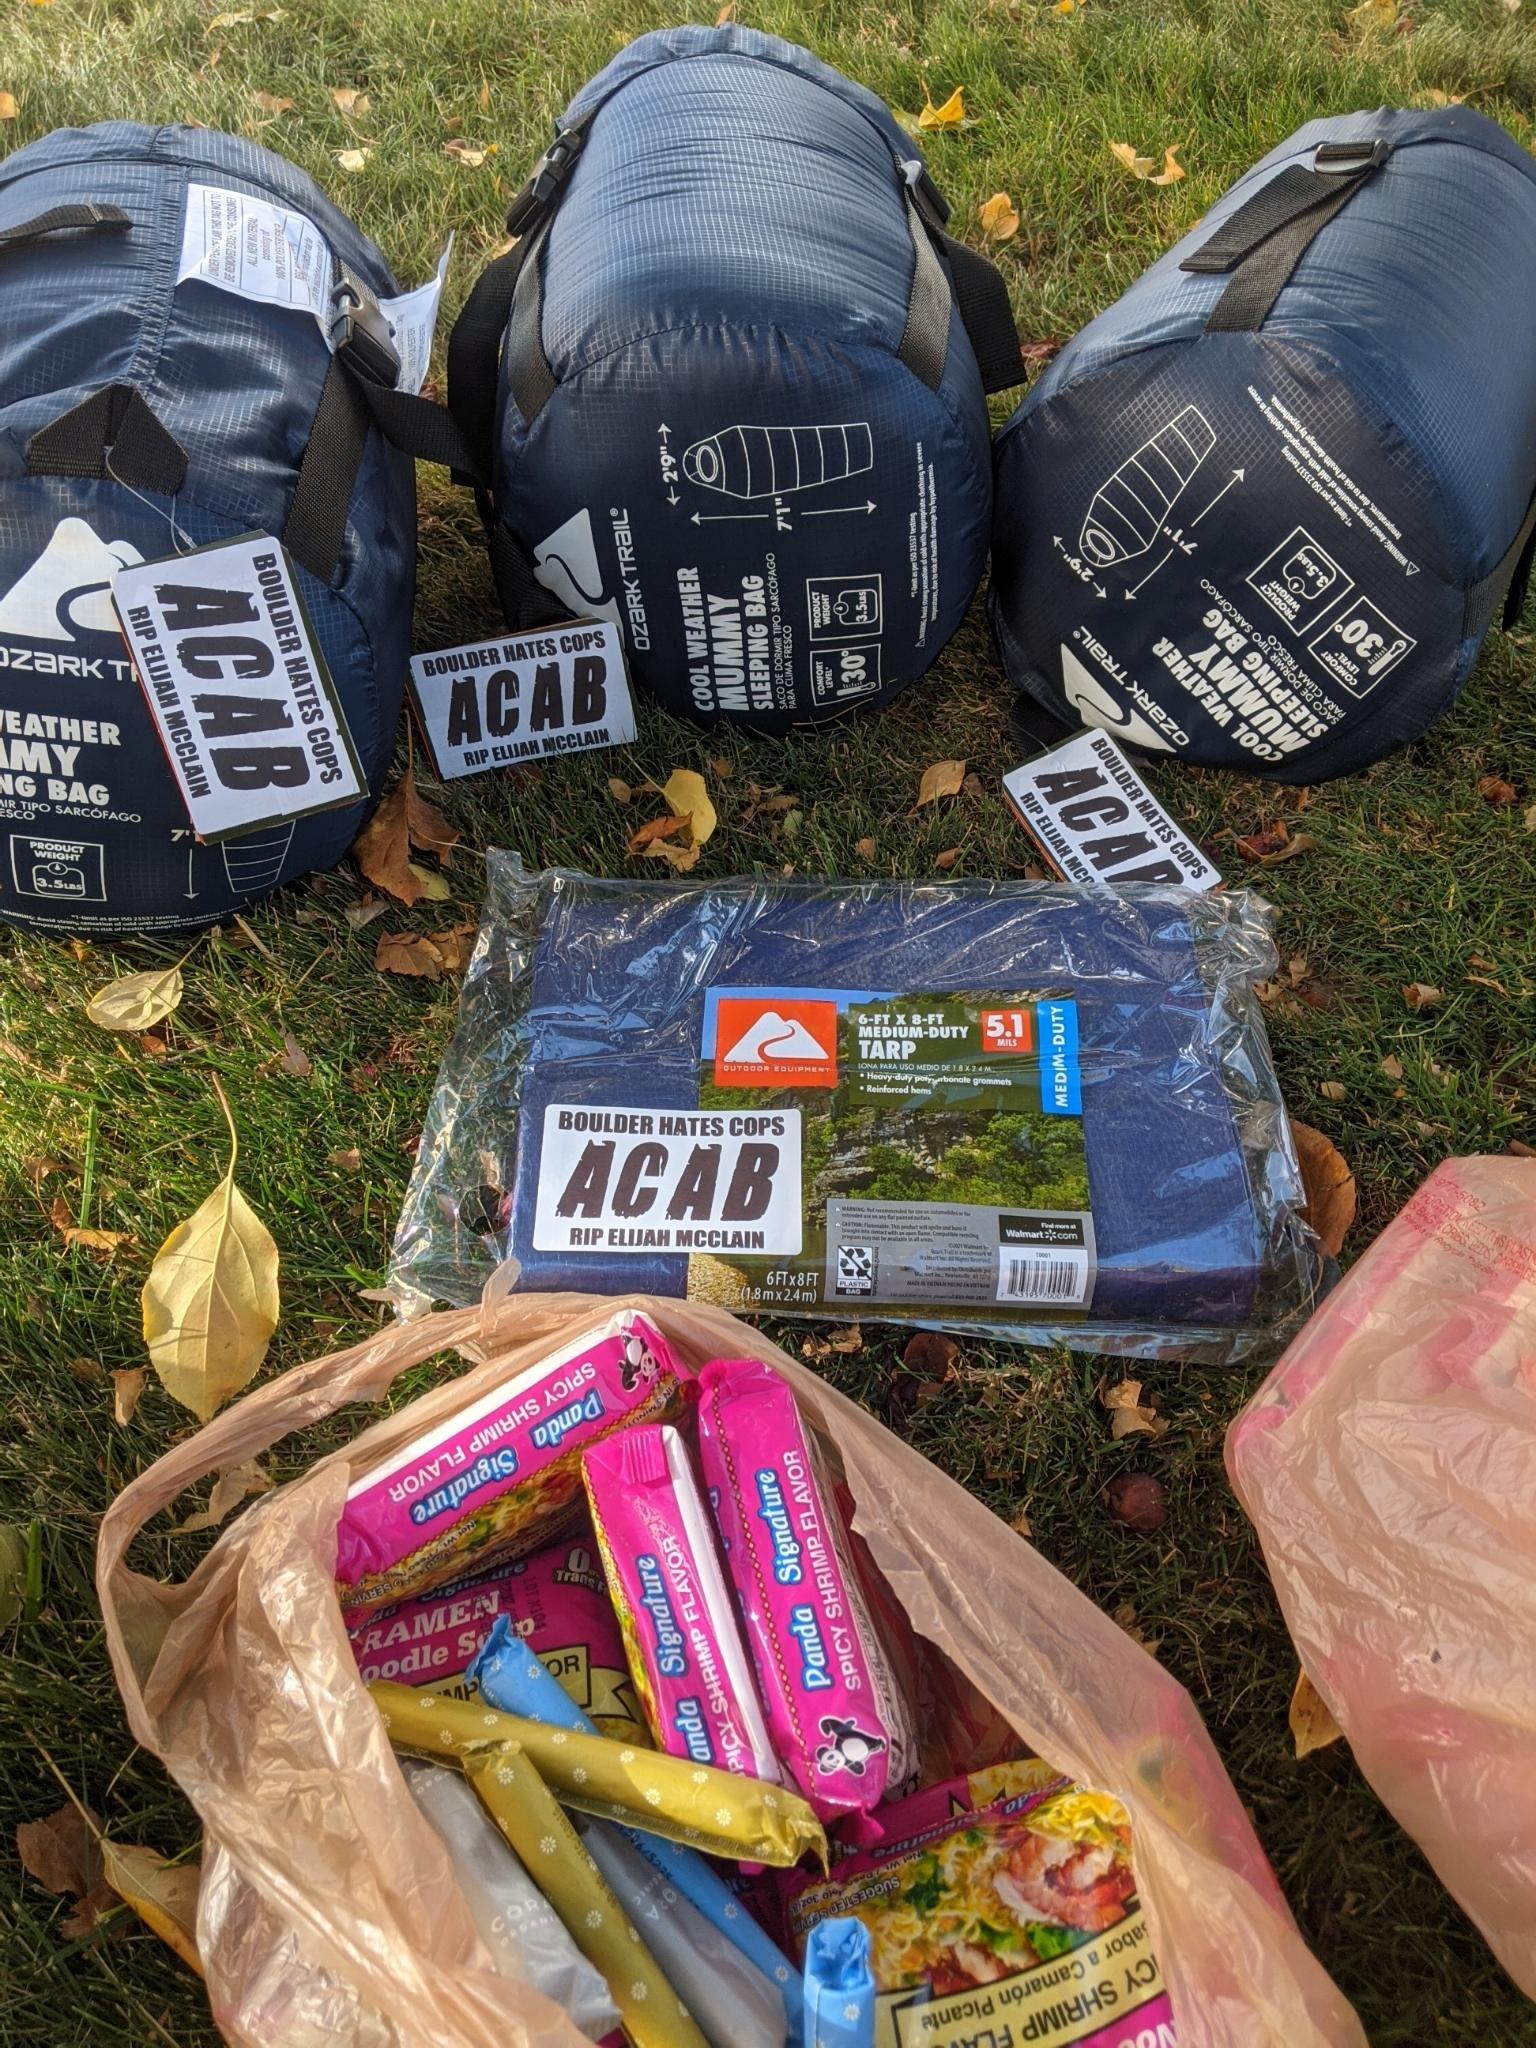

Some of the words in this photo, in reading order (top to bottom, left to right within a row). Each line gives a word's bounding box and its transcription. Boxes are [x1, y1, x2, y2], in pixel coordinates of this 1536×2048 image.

[1247, 384, 1263, 405] severe
[1299, 427, 1308, 439] by
[1305, 434, 1326, 458] damage
[1281, 445, 1301, 468] testing
[1308, 457, 1322, 472] with
[1323, 455, 1342, 476] health
[1297, 466, 1315, 484] 23537
[1312, 481, 1323, 493] ISO
[1318, 469, 1331, 482] cold
[1344, 478, 1356, 490] risk
[1320, 490, 1332, 501] per
[1359, 494, 1371, 506] due
[1357, 508, 1375, 528] strong
[741, 575, 768, 618] BAG
[765, 552, 781, 613] SARCÓFAGO
[1268, 580, 1301, 612] WEIGHT
[677, 566, 708, 660] WEATHER
[811, 591, 822, 629] PRODUCT
[821, 593, 831, 626] WEIGHT
[1200, 578, 1253, 633] SARCÓFAGO
[1260, 584, 1297, 621] PRODUCT
[128, 605, 157, 641] RIP
[771, 614, 781, 636] TIPO
[1202, 609, 1248, 655] BAG
[422, 647, 500, 677] BOULDER
[502, 638, 557, 662] HATES
[559, 630, 606, 654] COPS
[707, 593, 750, 712] MUMMY
[773, 636, 783, 672] DORMIR
[782, 625, 793, 659] FRESCO
[1252, 632, 1274, 656] TIPO
[1267, 635, 1299, 672] FRESCO
[141, 643, 181, 709] ELIJAH
[252, 553, 303, 654] BOULDER
[284, 655, 325, 725] HATES
[307, 727, 343, 785] COPS
[747, 623, 775, 710] SLEEPING
[775, 673, 784, 685] DE
[784, 659, 794, 687] CLIMA
[815, 660, 826, 696] COMFORT
[1152, 636, 1234, 728] WEATHER
[1270, 653, 1301, 690] DORMIR
[1297, 669, 1324, 698] CLIMA
[1320, 651, 1358, 686] COMFORT
[153, 583, 311, 791] ACAB
[447, 655, 607, 747] ACAB
[689, 664, 715, 712] COOL
[776, 686, 788, 710] SACO
[785, 688, 797, 709] PARA
[1188, 643, 1311, 753] MUMMY
[1242, 651, 1329, 738] SLEEPING
[1300, 688, 1312, 701] DE
[1312, 700, 1340, 725] SACO
[1324, 695, 1347, 719] PARA
[0, 709, 121, 746] EATHER
[1231, 722, 1284, 761] COOL
[164, 710, 211, 799] MCCLAIN
[463, 749, 489, 767] RIP
[492, 739, 541, 761] ELIJAH
[543, 728, 610, 752] MCCLAIN
[47, 778, 110, 806] BAG
[1090, 737, 1145, 802] BOULDER
[1135, 799, 1177, 844] HATES
[1169, 841, 1209, 880] COPS
[20, 800, 51, 813] TIPO
[55, 804, 142, 823] SARCÓFAGO
[1019, 791, 1044, 818] RIP
[1035, 815, 1068, 859] ELIJAH
[29, 841, 85, 854] PRODUCT
[34, 850, 81, 862] WEIGHT
[858, 1013, 890, 1025] 6-FT
[895, 1014, 907, 1025] X
[911, 1013, 945, 1025] 8-FT
[858, 1026, 969, 1039] MEDIUM-DUTY
[986, 1014, 1024, 1038] 5.1
[858, 1040, 917, 1060] TARP
[996, 1038, 1018, 1047] MILS
[1050, 1006, 1069, 1108] MEDIM-DUTY
[858, 1062, 878, 1070] LONA
[879, 1063, 898, 1071] PARA
[899, 1063, 915, 1071] USO
[916, 1063, 940, 1072] MEDIO
[941, 1064, 951, 1072] DE
[866, 1072, 913, 1084] Heavy-duty
[972, 1077, 1012, 1087] grommets
[866, 1085, 909, 1094] Reinforced
[910, 1085, 932, 1095] hems
[558, 1110, 654, 1135] BOULDER
[659, 1116, 724, 1137] HATES
[729, 1116, 785, 1136] COPS
[555, 1139, 780, 1222] ACAB
[569, 1227, 604, 1246] RIP
[607, 1228, 670, 1247] ELIJAH
[675, 1230, 765, 1249] MCCLAIN
[1005, 1228, 1044, 1239] Walmart
[543, 1362, 596, 1405] SPICY
[469, 1400, 540, 1454] SHRIMP
[532, 1390, 605, 1448] Panda
[388, 1451, 467, 1502] FLAVOR
[412, 1447, 517, 1523] Signature
[783, 1449, 817, 1537] FLAVOR
[757, 1470, 802, 1583] Signature
[556, 1568, 594, 1587] Trans
[664, 1535, 700, 1626] FLAVOR
[809, 1536, 843, 1620] SHRIMP
[362, 1590, 500, 1653] RAMEN
[637, 1556, 685, 1674] Signature
[792, 1606, 832, 1689] Panda
[831, 1625, 862, 1691] SPICY
[689, 1628, 729, 1715] SHRIMP
[677, 1699, 711, 1762] anda
[717, 1721, 747, 1777] PICY
[1088, 1952, 1100, 1965] a
[998, 1960, 1086, 2008] Camarón
[921, 1996, 996, 2030] Picante
[1022, 1980, 1119, 2043] SHRIMP
